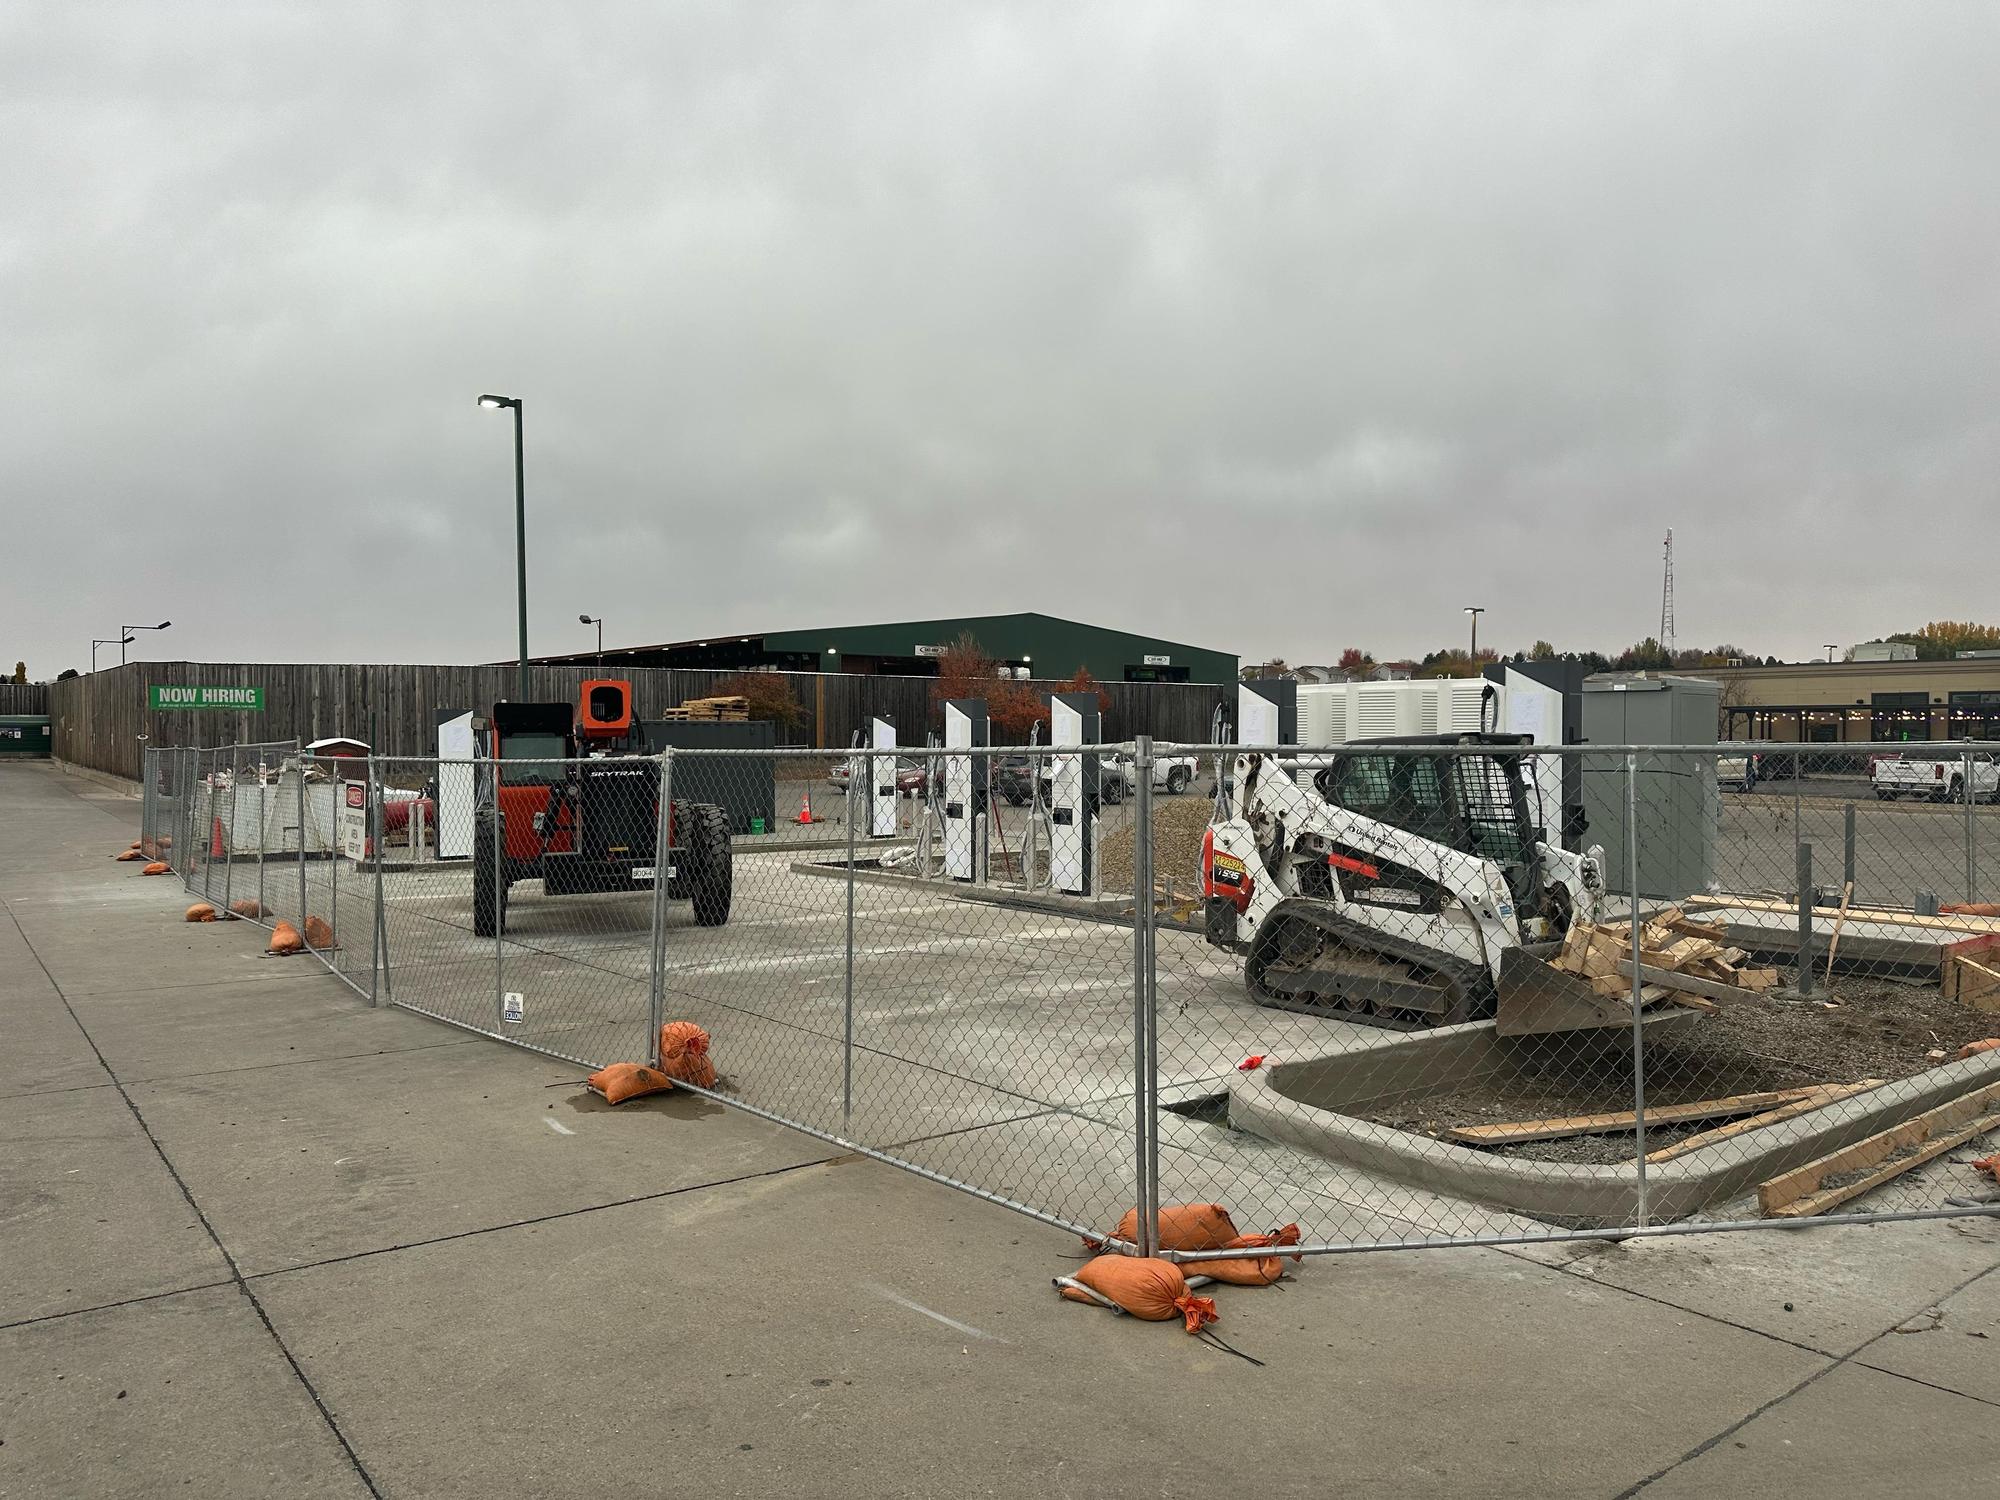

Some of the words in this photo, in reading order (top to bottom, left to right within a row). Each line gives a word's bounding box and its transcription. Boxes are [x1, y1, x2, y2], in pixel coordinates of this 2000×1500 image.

[159, 688, 197, 703] NOW
[202, 689, 256, 704] HIRING
[1356, 828, 1376, 841] United
[1376, 837, 1398, 851] Rentals
